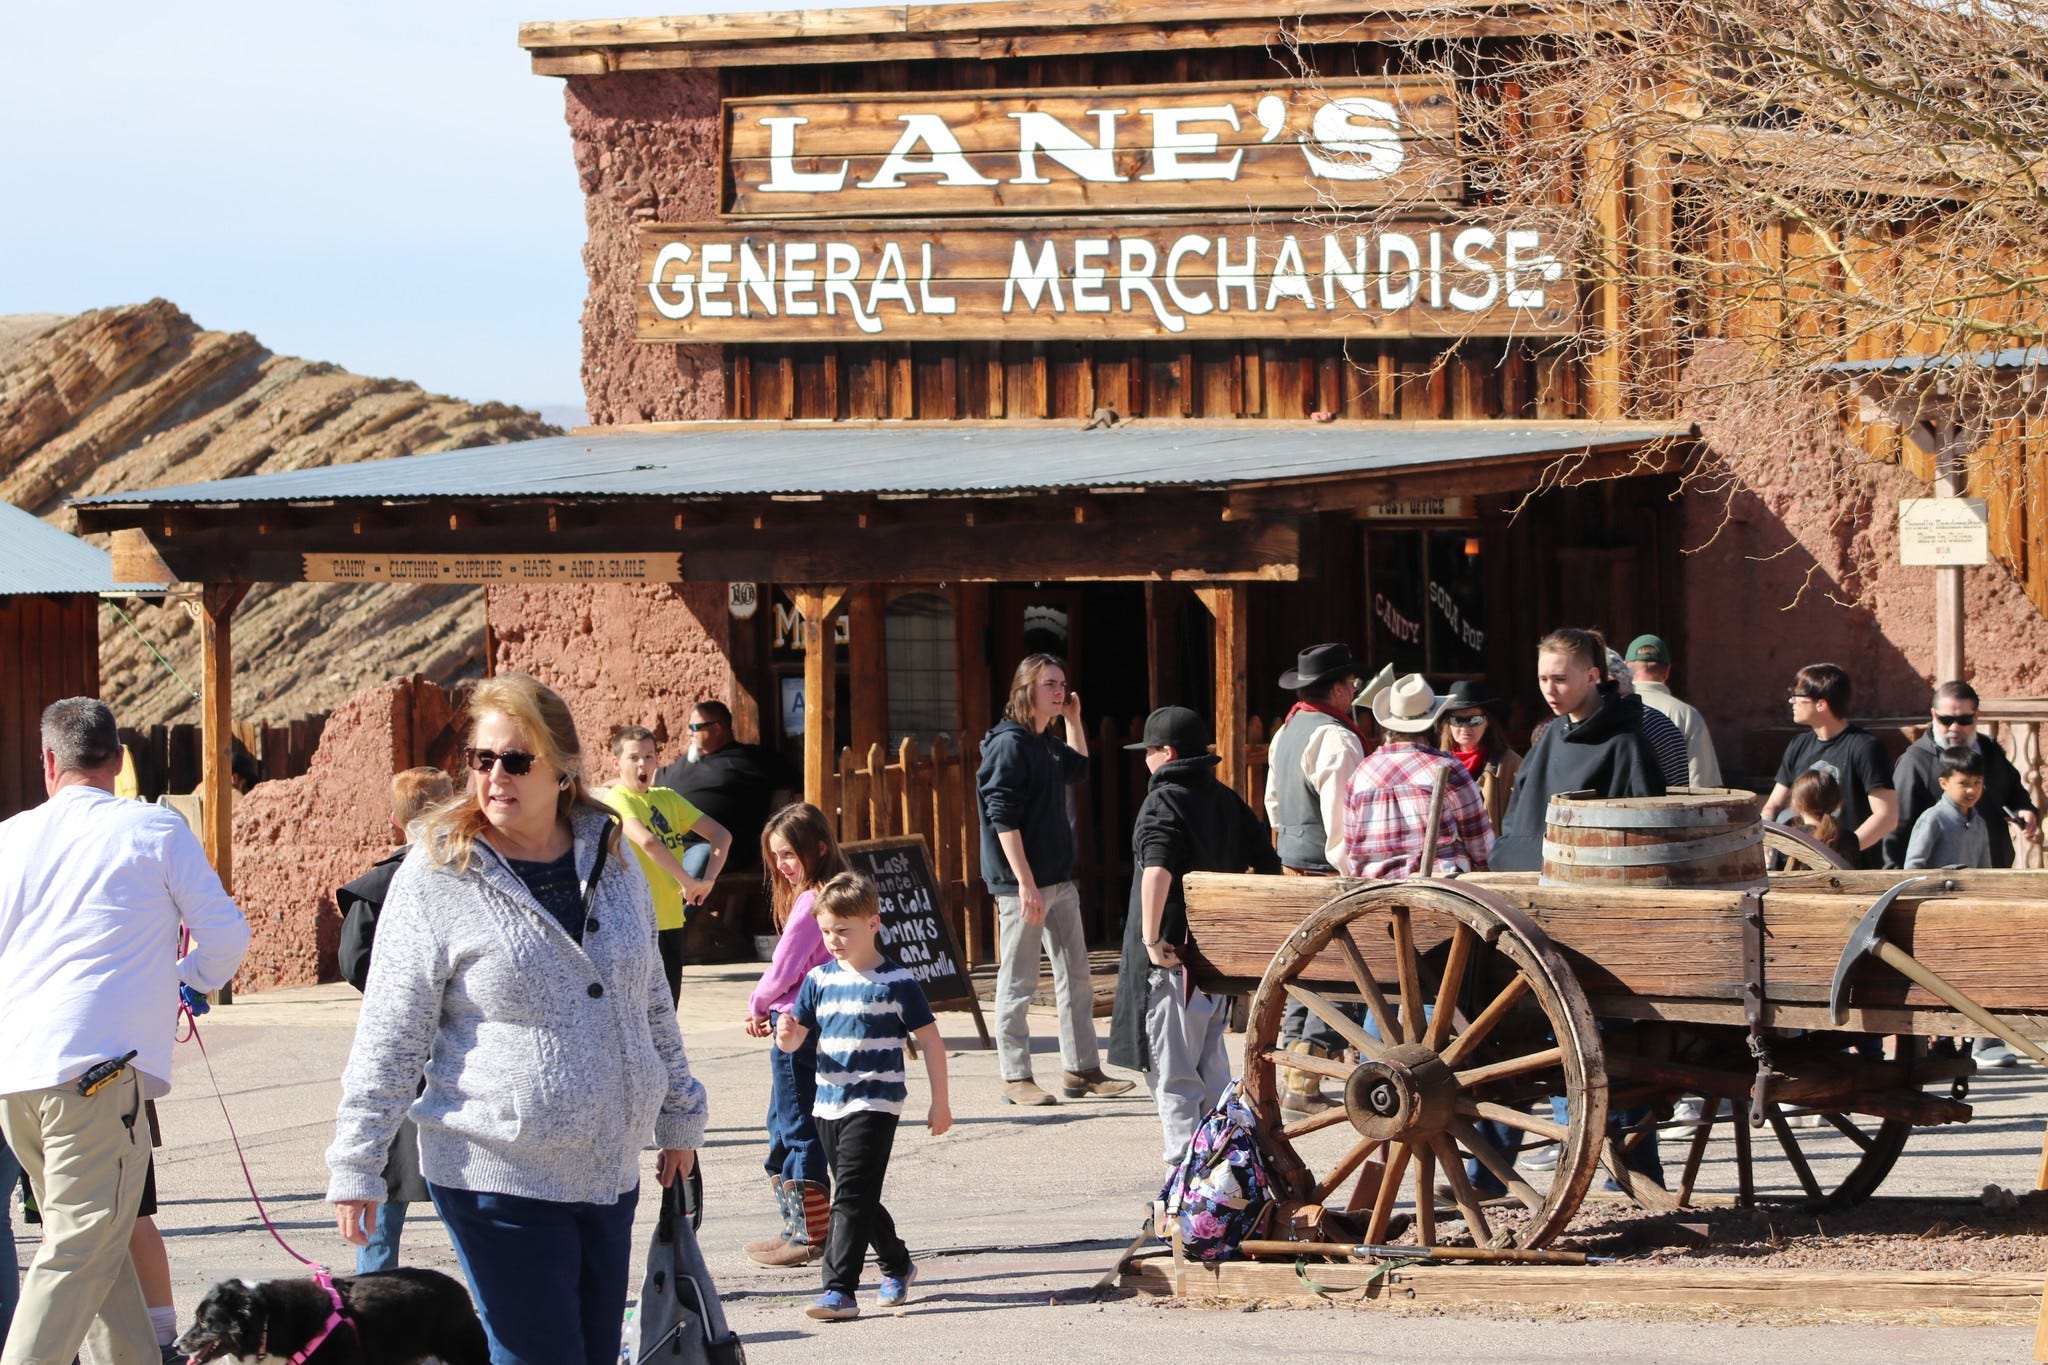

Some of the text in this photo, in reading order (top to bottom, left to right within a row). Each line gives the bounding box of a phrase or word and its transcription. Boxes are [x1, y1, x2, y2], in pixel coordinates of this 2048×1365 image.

[757, 95, 1405, 193] LANE'S
[649, 227, 1563, 334] GENERAL MERCHANDISE
[332, 559, 646, 578] CANDY CLOTHING SUPPLIES HATS AND A SMILE
[731, 583, 755, 606] 10
[1375, 593, 1421, 644] CANDY
[1429, 581, 1485, 651] SODA POP
[869, 852, 909, 874] Last
[878, 887, 932, 915] ce Cold
[900, 941, 931, 963] and
